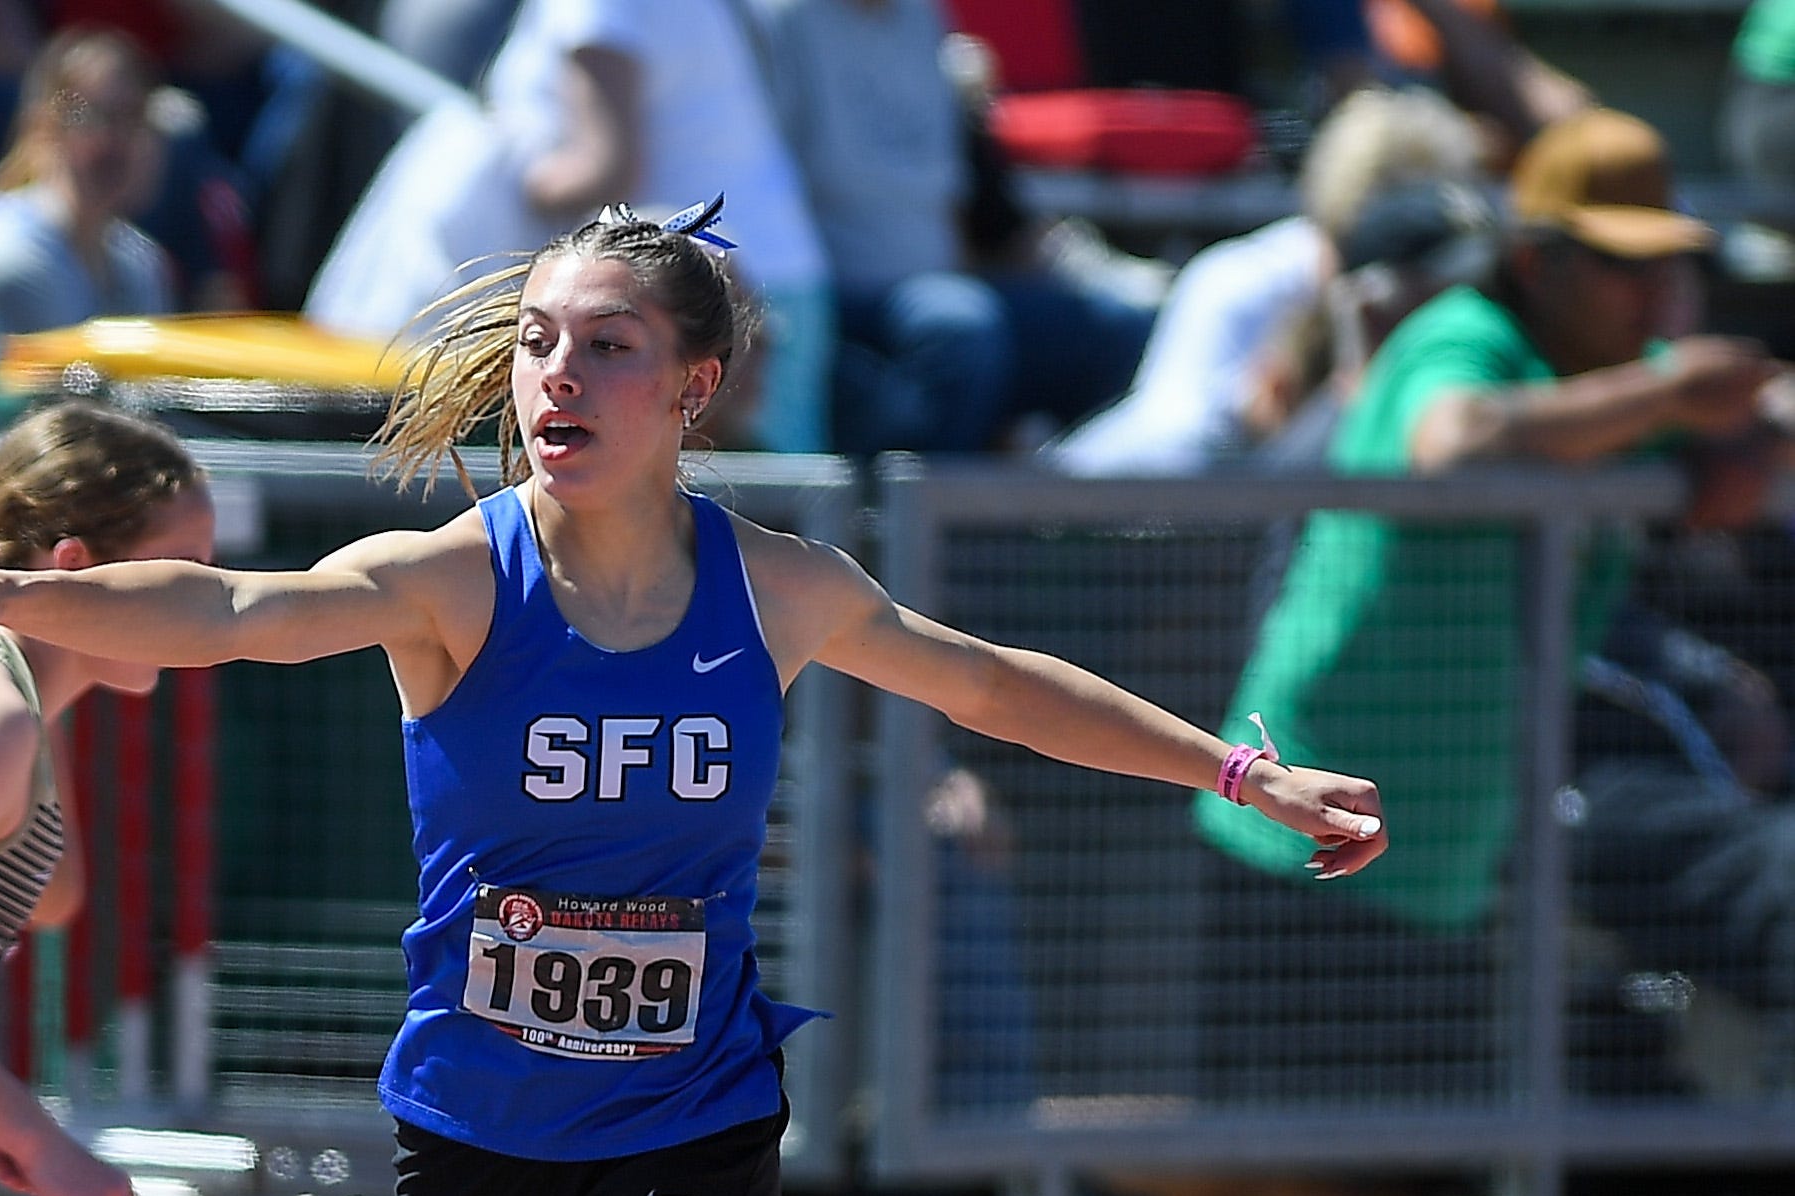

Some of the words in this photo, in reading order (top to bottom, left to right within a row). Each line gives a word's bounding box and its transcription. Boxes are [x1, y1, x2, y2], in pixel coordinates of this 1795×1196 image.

[522, 714, 732, 802] SFC
[557, 897, 618, 912] Howard
[626, 900, 667, 913] Wood
[550, 910, 612, 928] DAKOTA
[619, 912, 680, 930] RELAYS
[482, 944, 692, 1034] 1939
[557, 1035, 636, 1056] Anniversary
